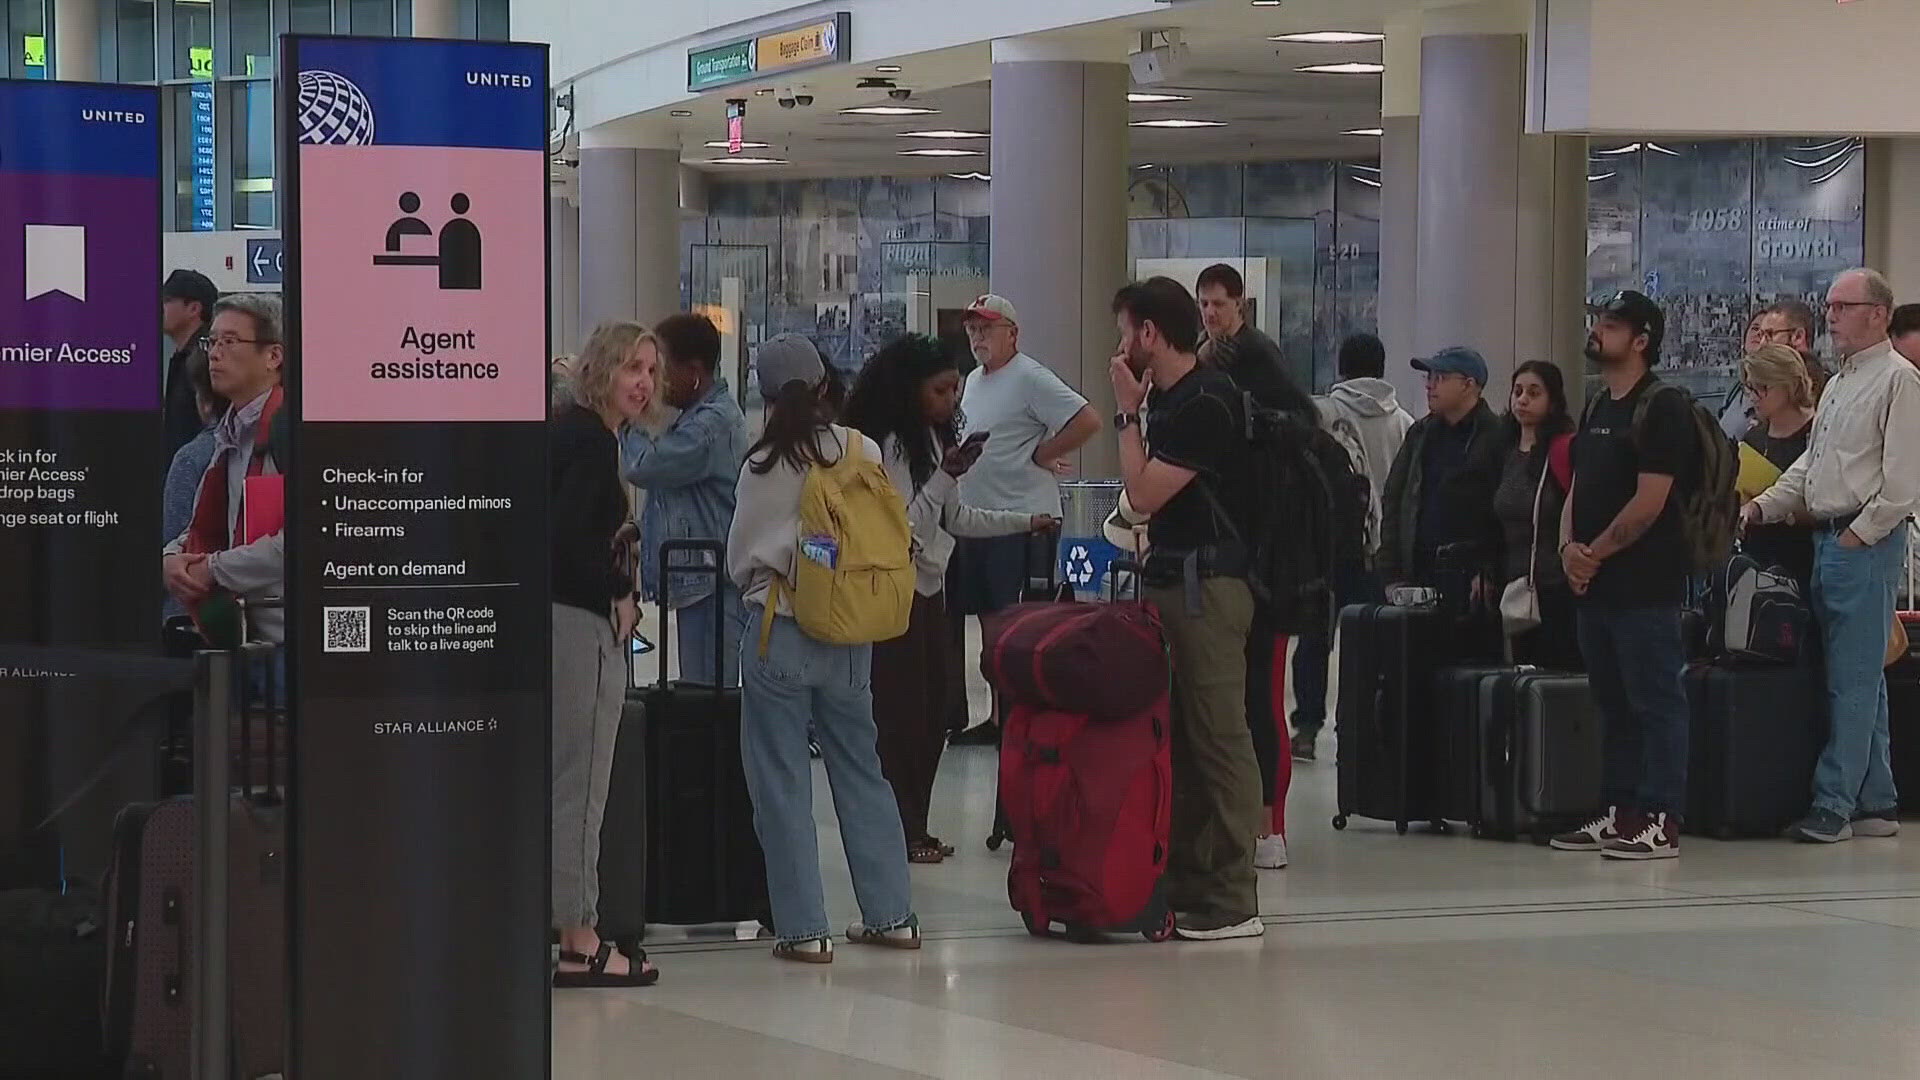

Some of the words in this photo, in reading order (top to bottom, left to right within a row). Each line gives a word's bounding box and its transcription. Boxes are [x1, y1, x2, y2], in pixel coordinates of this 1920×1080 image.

[466, 72, 532, 88] UNITED
[82, 109, 145, 124] UNITED
[1687, 207, 1743, 232] 1958
[1758, 222, 1766, 231] a
[1767, 216, 1794, 231] time
[1796, 216, 1812, 232] of
[1758, 236, 1838, 259] Growth
[401, 326, 476, 355] Agent
[0, 342, 53, 362] mier
[370, 357, 499, 379] assistance
[18, 449, 33, 463] in
[35, 449, 57, 463] for
[322, 468, 398, 484] Check-in
[401, 468, 424, 483] for
[0, 485, 34, 502] drop
[37, 485, 75, 502] bags
[334, 495, 466, 513] Unaccompanied
[468, 495, 512, 509] minors
[29, 512, 64, 525] seat
[66, 514, 82, 525] or
[84, 511, 119, 528] flight
[334, 523, 406, 537] Firearms
[323, 561, 375, 580] Agent
[377, 564, 398, 576] on
[401, 560, 466, 576] demand
[387, 608, 421, 621] Scan
[423, 608, 445, 620] the
[446, 607, 465, 622] QR
[466, 606, 495, 619] code
[387, 625, 402, 636] to
[404, 623, 430, 638] skip
[432, 623, 452, 635] the
[454, 623, 475, 634] line
[476, 621, 497, 634] and
[387, 639, 412, 651] talk
[414, 640, 429, 651] to
[429, 642, 438, 651] a
[439, 638, 460, 650] live
[462, 638, 495, 652] agent
[11, 667, 77, 677] ALLIA
[373, 722, 413, 734] STAR
[416, 719, 485, 734] ALLIANCE
